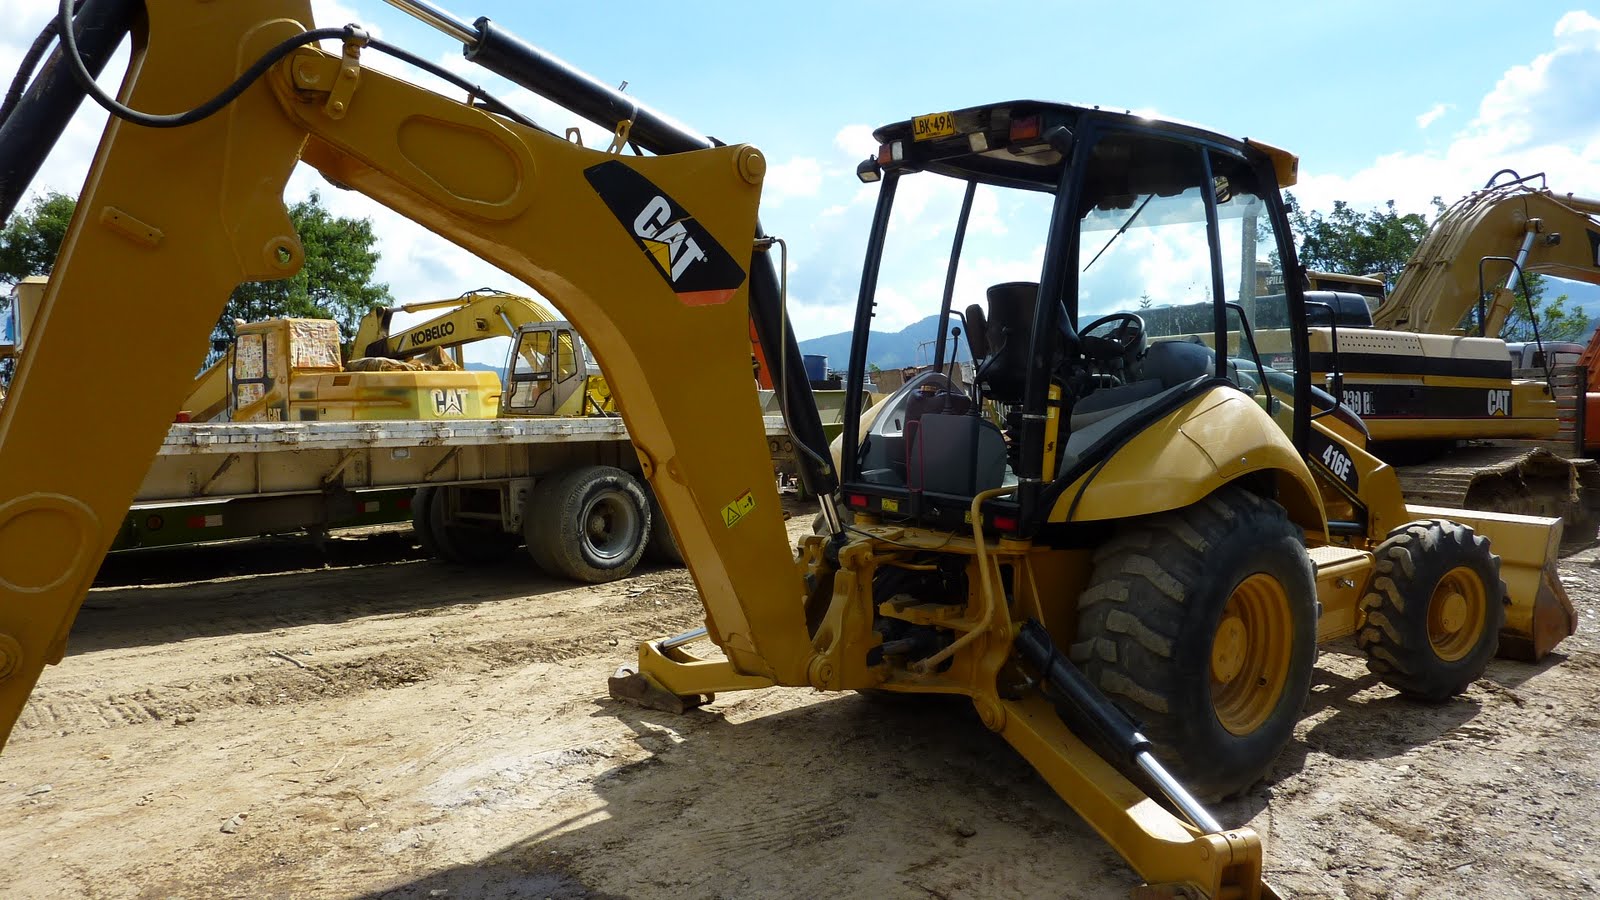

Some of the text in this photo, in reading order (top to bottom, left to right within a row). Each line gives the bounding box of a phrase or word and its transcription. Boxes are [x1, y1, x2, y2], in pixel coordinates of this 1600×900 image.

[634, 195, 705, 283] CAT
[411, 321, 454, 347] KOBELCO
[268, 408, 281, 421] CAT
[430, 388, 468, 417] CAT
[1488, 389, 1510, 416] CAT
[1322, 444, 1352, 482] 416E
